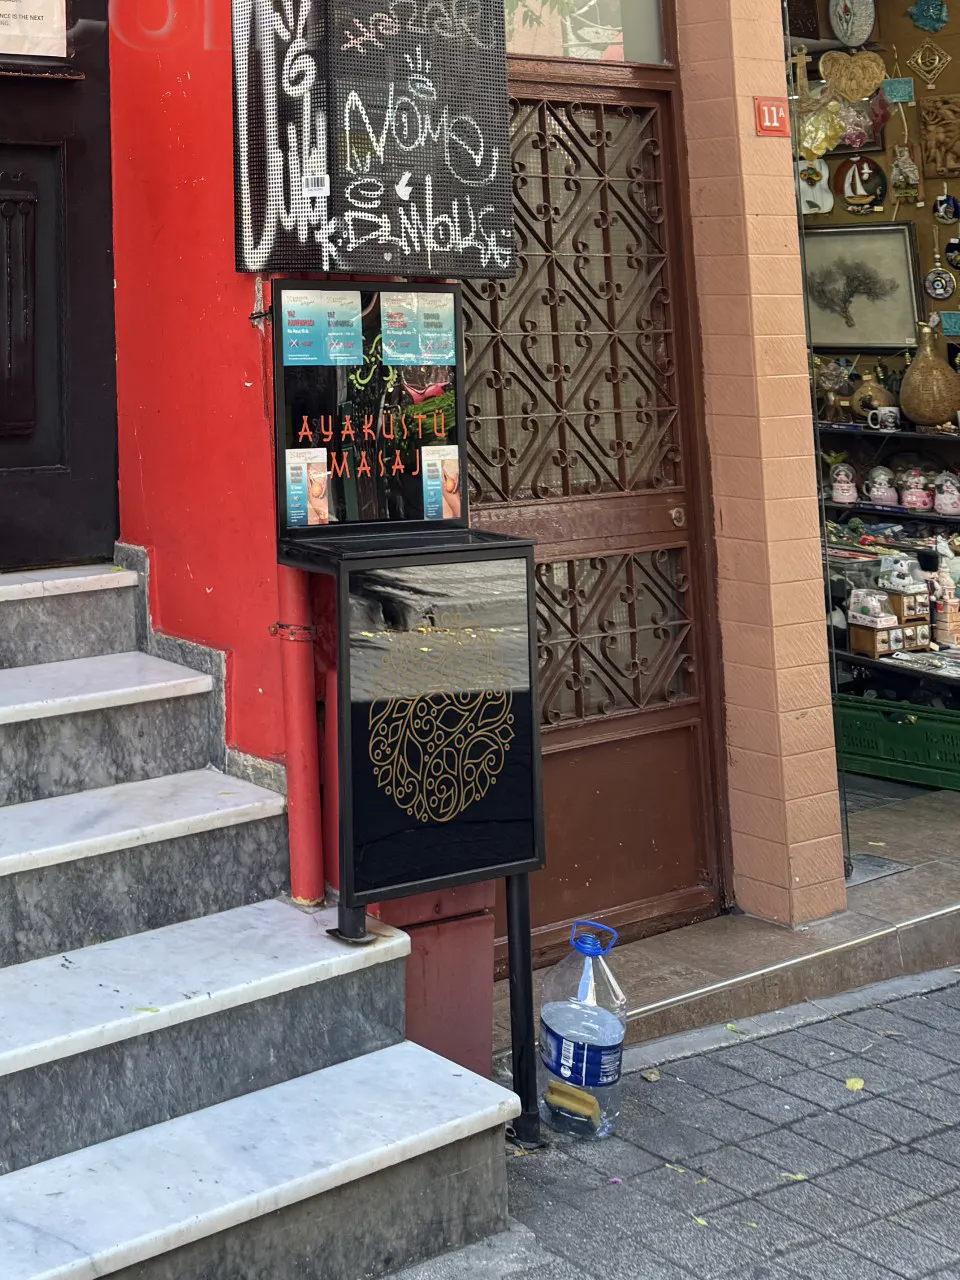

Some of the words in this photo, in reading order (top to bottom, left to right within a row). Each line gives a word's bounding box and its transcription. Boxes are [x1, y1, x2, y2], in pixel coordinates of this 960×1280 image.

[29, 14, 45, 22] NEXT
[298, 409, 446, 443] AYAKÜSTÜ
[330, 448, 420, 479] MASAJ
